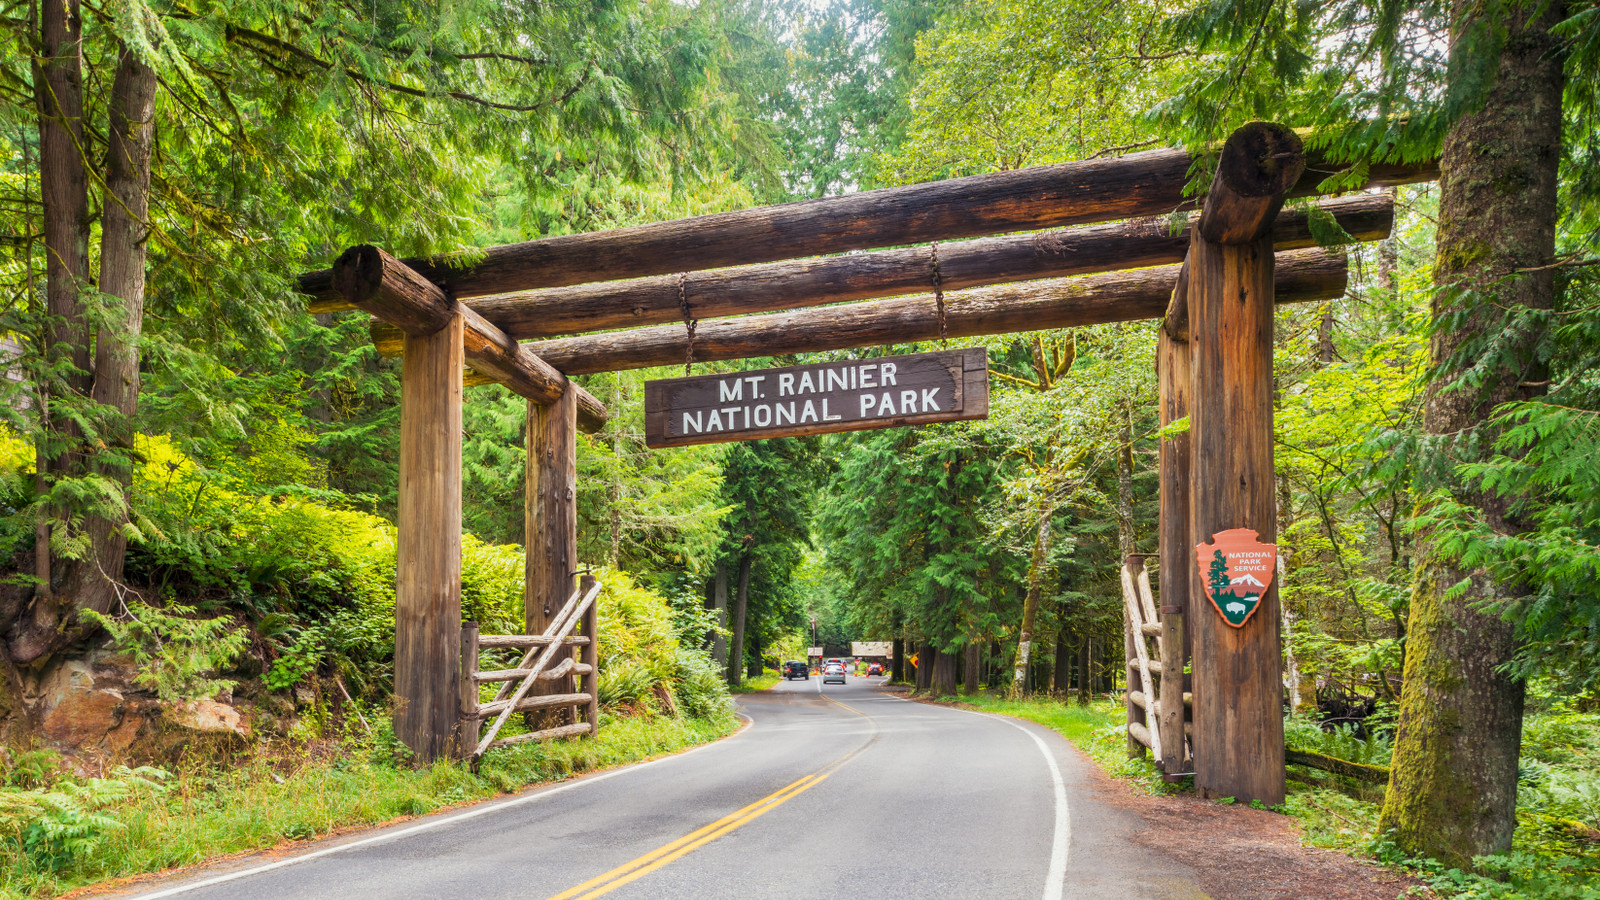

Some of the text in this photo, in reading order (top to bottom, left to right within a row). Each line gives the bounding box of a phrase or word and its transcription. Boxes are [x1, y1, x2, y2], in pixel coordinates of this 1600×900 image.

[719, 362, 897, 403] MT. RAINIER
[682, 387, 941, 435] NATIONAL PARK
[1228, 551, 1272, 559] NATIONAL
[1233, 564, 1267, 572] SERVICE
